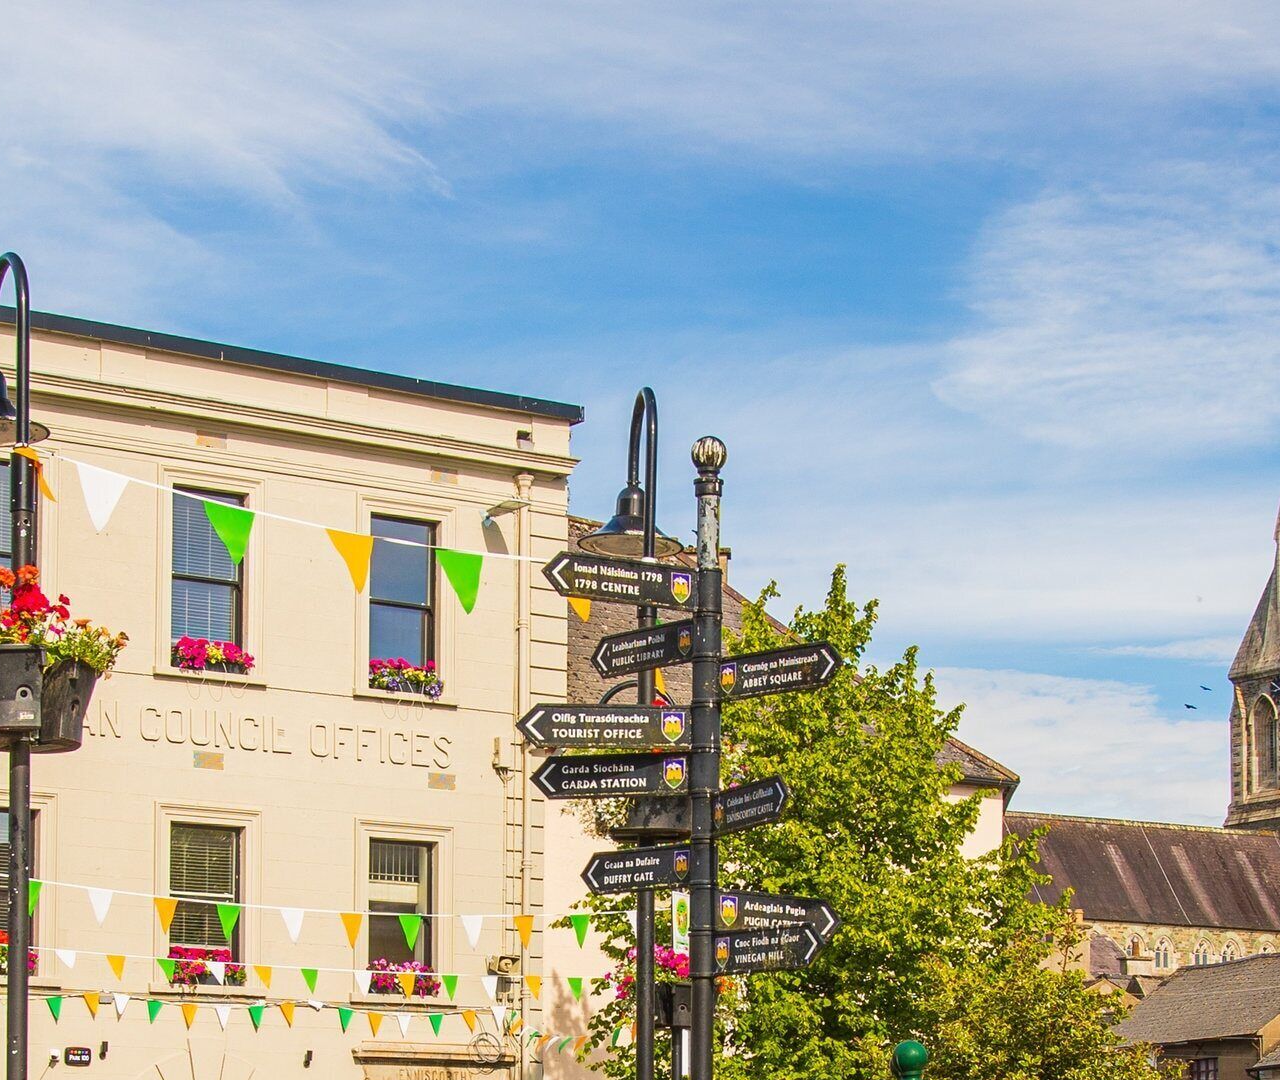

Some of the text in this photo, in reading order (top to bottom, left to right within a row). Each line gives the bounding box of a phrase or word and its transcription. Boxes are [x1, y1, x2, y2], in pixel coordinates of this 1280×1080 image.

[573, 562, 598, 575] Ionad
[641, 571, 663, 583] 1798
[574, 578, 640, 595] 1798 CENTRE
[612, 648, 665, 667] PUBLIC LIBRARY
[769, 661, 777, 669] na
[779, 652, 819, 667] Mainistreach
[742, 670, 803, 689] ABBEY SQUARE
[551, 713, 650, 724] Oifig Turasóireachta
[140, 704, 292, 755] COUNCIL
[310, 720, 453, 770] OFFICES
[552, 728, 643, 739] TOURIST OFFICE
[561, 763, 635, 775] Garda Síochána
[561, 777, 647, 789] GARDA STATION
[757, 802, 774, 815] CASTLE
[604, 860, 624, 869] Geata
[635, 857, 660, 867] Dufaire
[604, 871, 654, 885] DUFFRY GATE
[785, 904, 806, 916] Pugin
[744, 916, 770, 927] PUGIN
[734, 950, 784, 964] VINEGAR HILL
